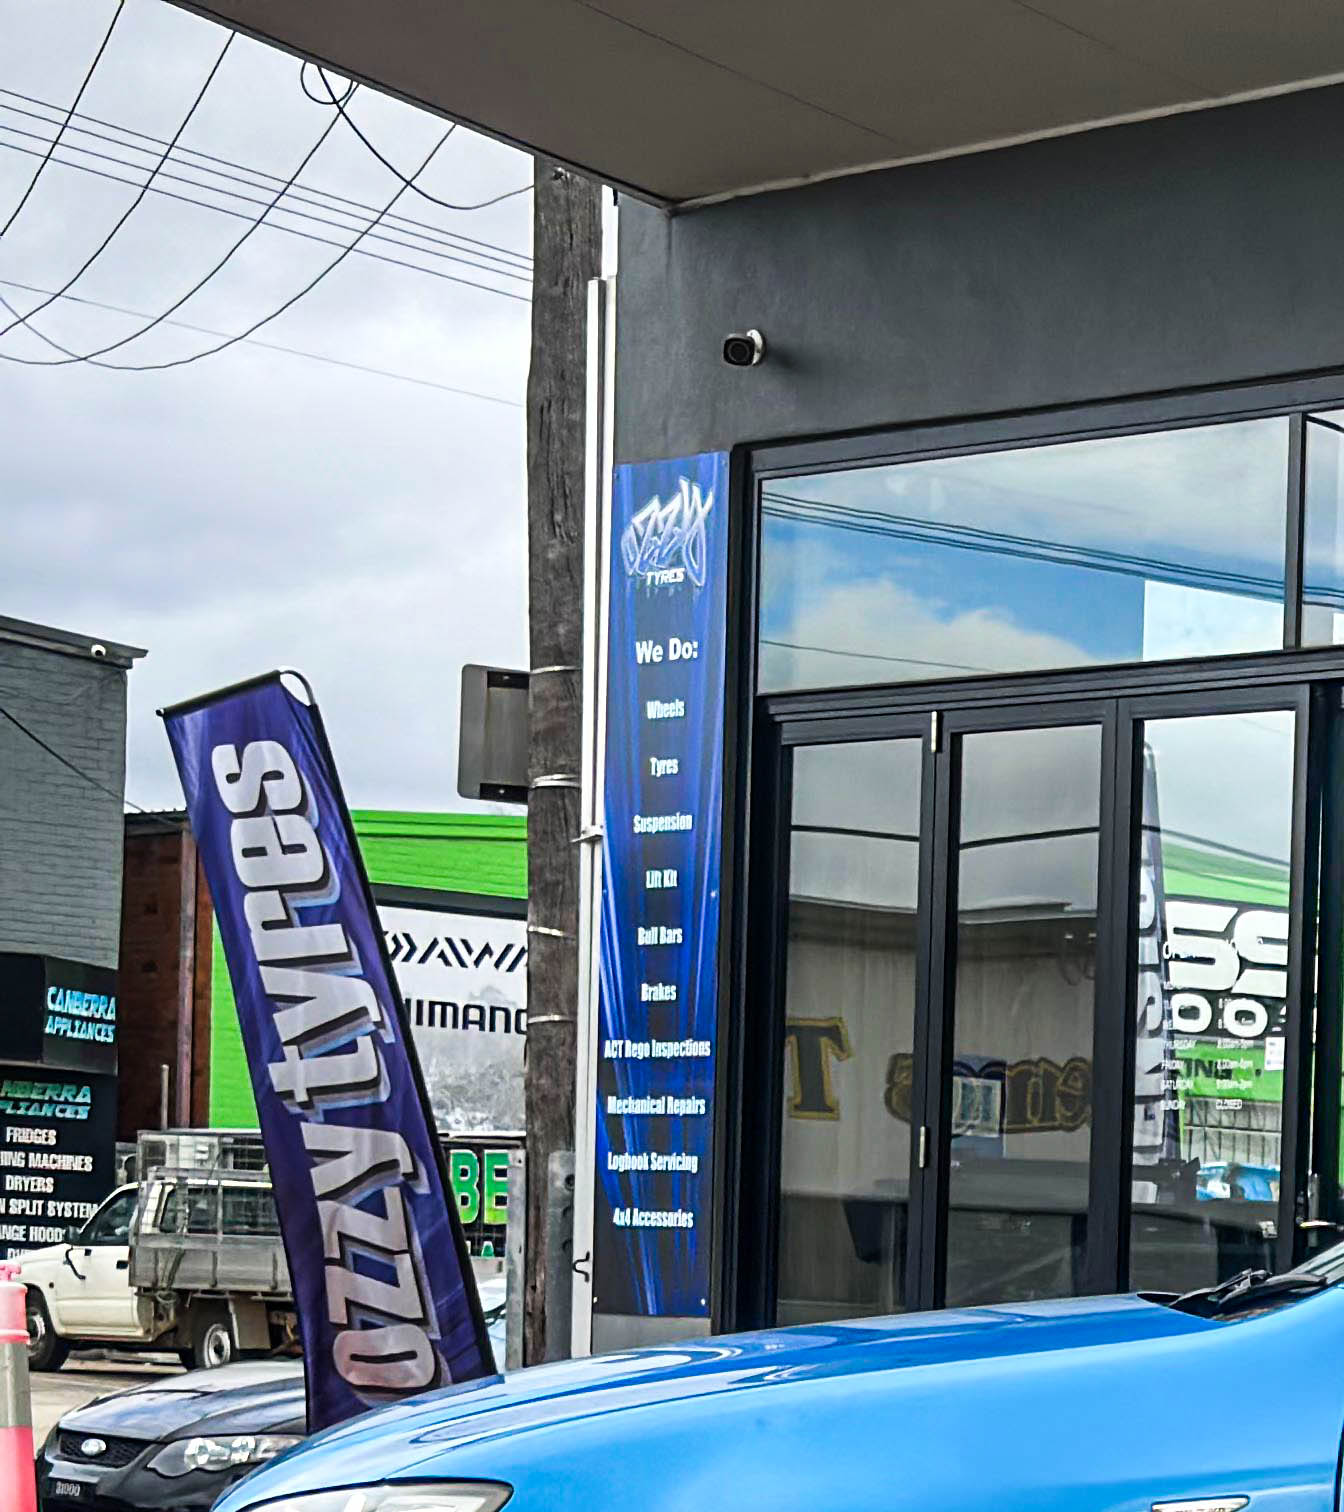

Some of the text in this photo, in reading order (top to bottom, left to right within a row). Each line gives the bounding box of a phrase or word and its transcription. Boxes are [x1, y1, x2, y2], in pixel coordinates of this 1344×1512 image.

[646, 568, 686, 586] TYRES
[635, 637, 699, 665] We Do:
[646, 698, 685, 719] Wheels
[650, 757, 679, 777] Tyres
[633, 812, 693, 834] Suspension
[211, 739, 383, 1098] tyres
[659, 927, 683, 945] Bars
[641, 982, 677, 1001] Brakes
[47, 986, 116, 1022] CANBERRA
[45, 1016, 116, 1043] APPLIANCES
[604, 1040, 623, 1058] ACT
[651, 1038, 711, 1059] Inspections
[607, 1095, 706, 1117] Mechanical Repairs
[6, 1126, 57, 1146] FRIDGES
[28, 1153, 93, 1172] MACHINES
[607, 1151, 698, 1174] Logbook Servicing
[5, 1174, 54, 1193] DRYERS
[8, 1198, 45, 1216] SPLIT
[613, 1207, 694, 1228] 4x4 Accessories
[302, 1122, 440, 1389] ozzy
